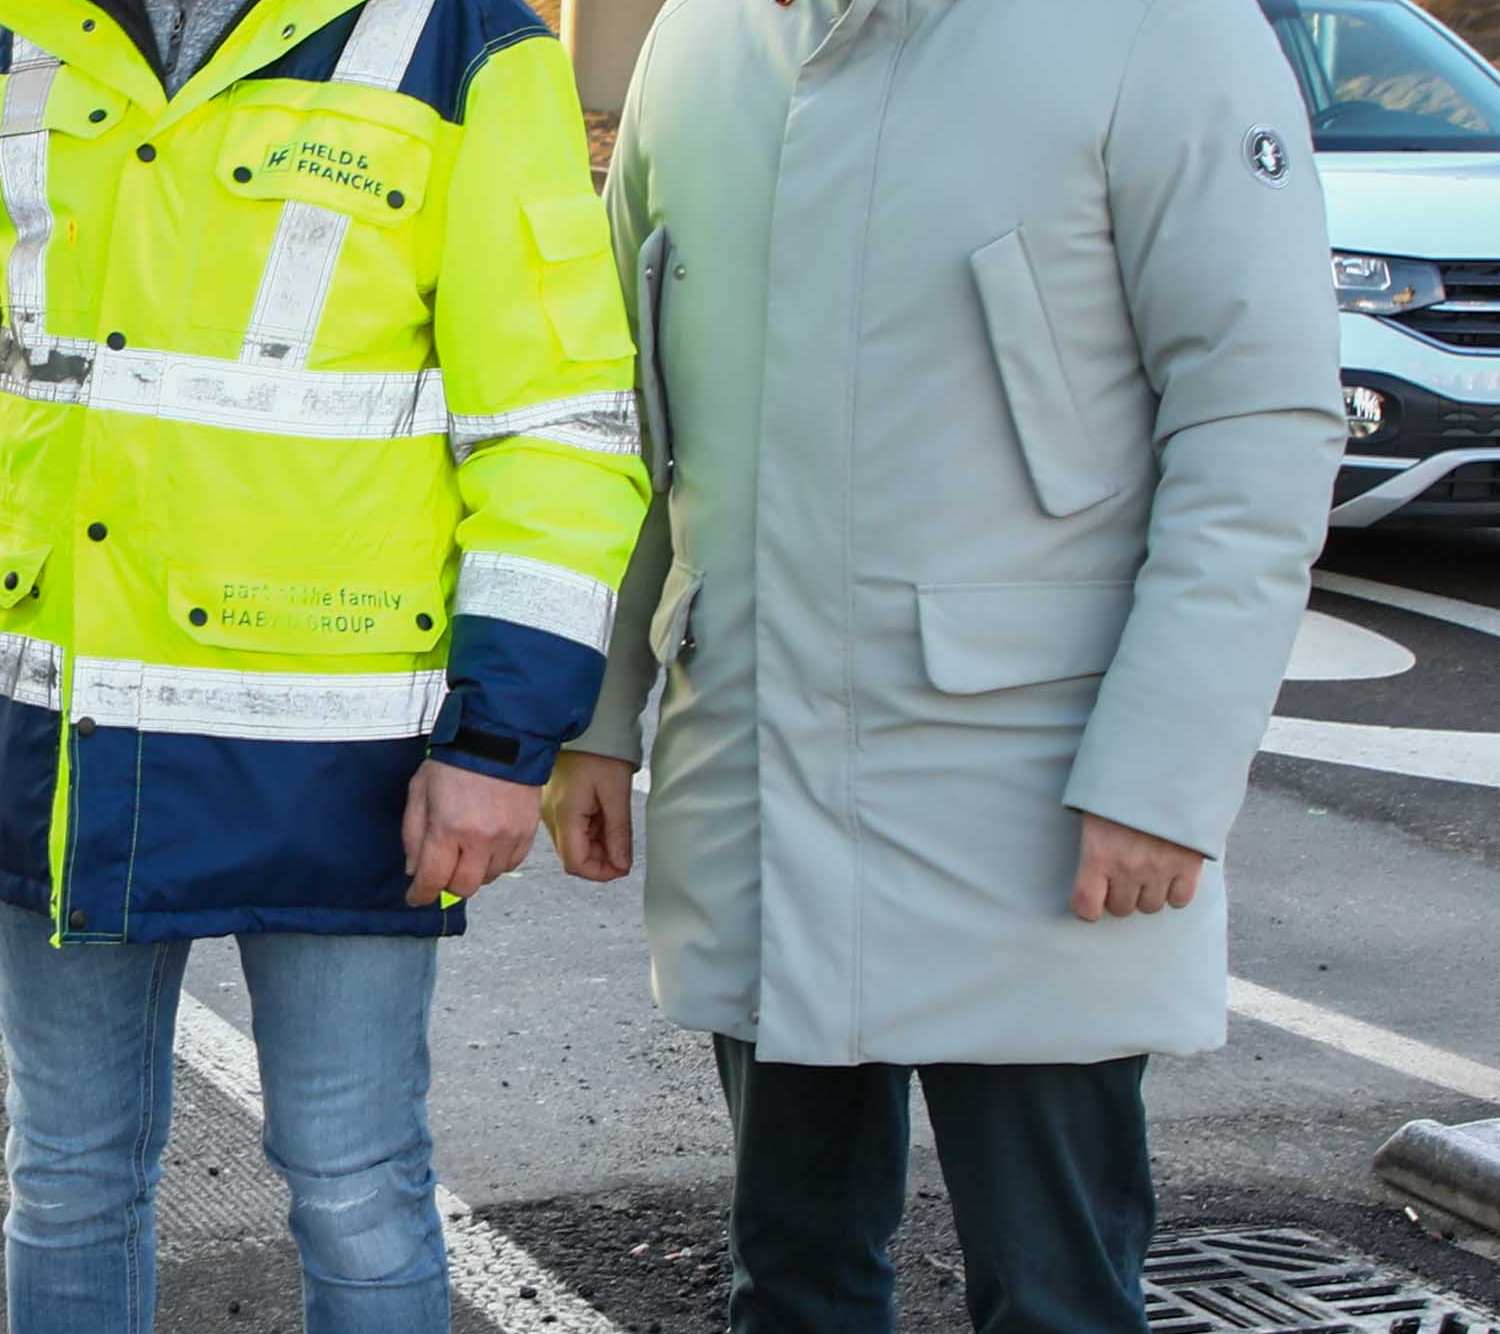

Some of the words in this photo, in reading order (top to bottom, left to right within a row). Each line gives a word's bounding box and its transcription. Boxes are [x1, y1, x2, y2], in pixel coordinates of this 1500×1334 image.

[302, 142, 353, 165] HELD
[357, 155, 368, 169] &
[298, 160, 382, 196] FRANCKE
[339, 588, 402, 610] family
